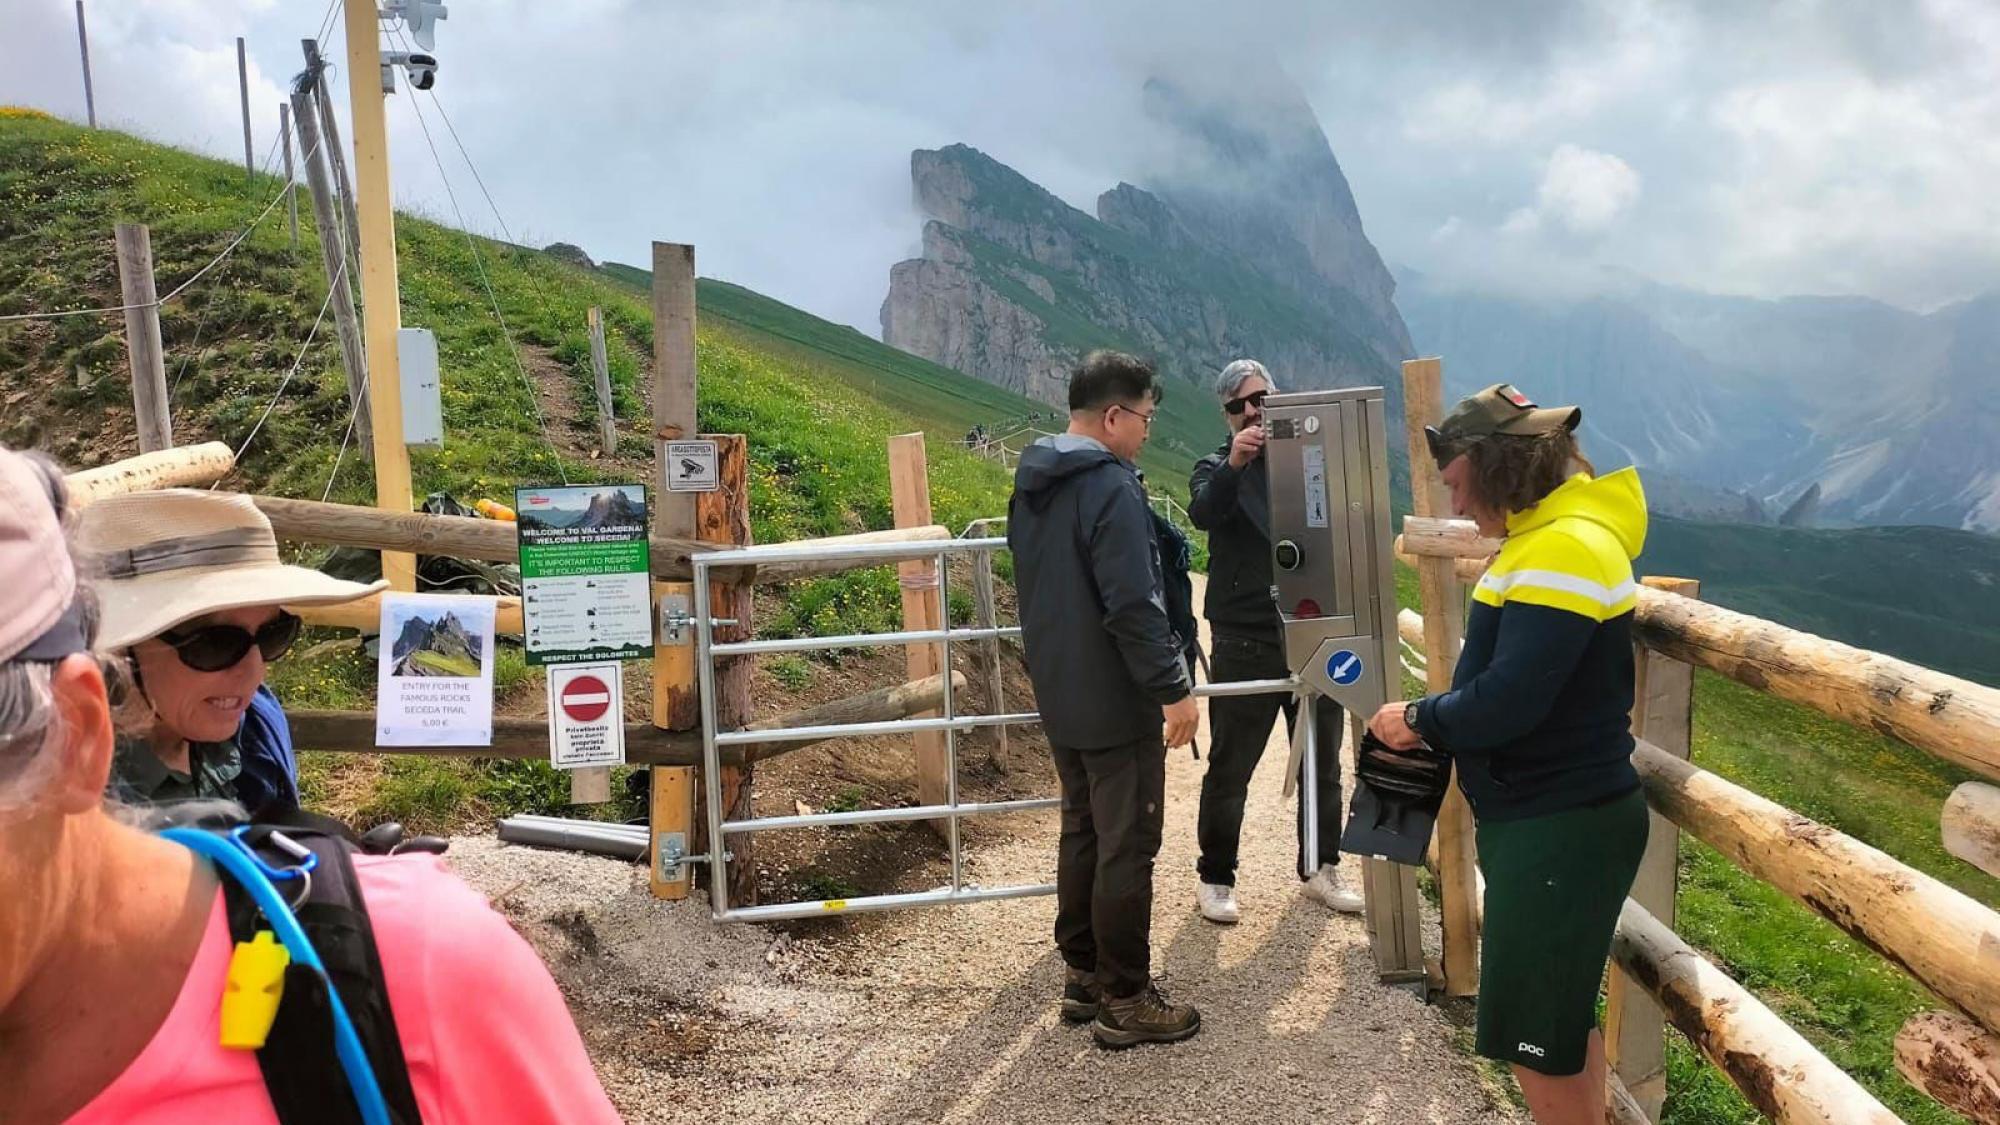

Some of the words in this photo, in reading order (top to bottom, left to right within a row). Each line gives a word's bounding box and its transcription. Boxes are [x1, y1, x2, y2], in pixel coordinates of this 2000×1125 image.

[522, 528, 567, 536] WELCOME
[600, 525, 644, 533] GARDENA!
[537, 536, 580, 545] WELCOME
[544, 558, 591, 567] IMPORTANT
[592, 557, 603, 565] TO
[604, 555, 641, 563] RESPECT
[540, 568, 556, 576] THE
[556, 566, 603, 575] FOLLOWING
[541, 654, 576, 662] RESPECT
[595, 650, 640, 659] DOLOMITES
[402, 683, 431, 691] ENTRY
[432, 683, 451, 691] FOR
[400, 694, 438, 702] FAMOUS
[440, 694, 471, 702] ROCKS
[443, 705, 466, 714] TRAIL
